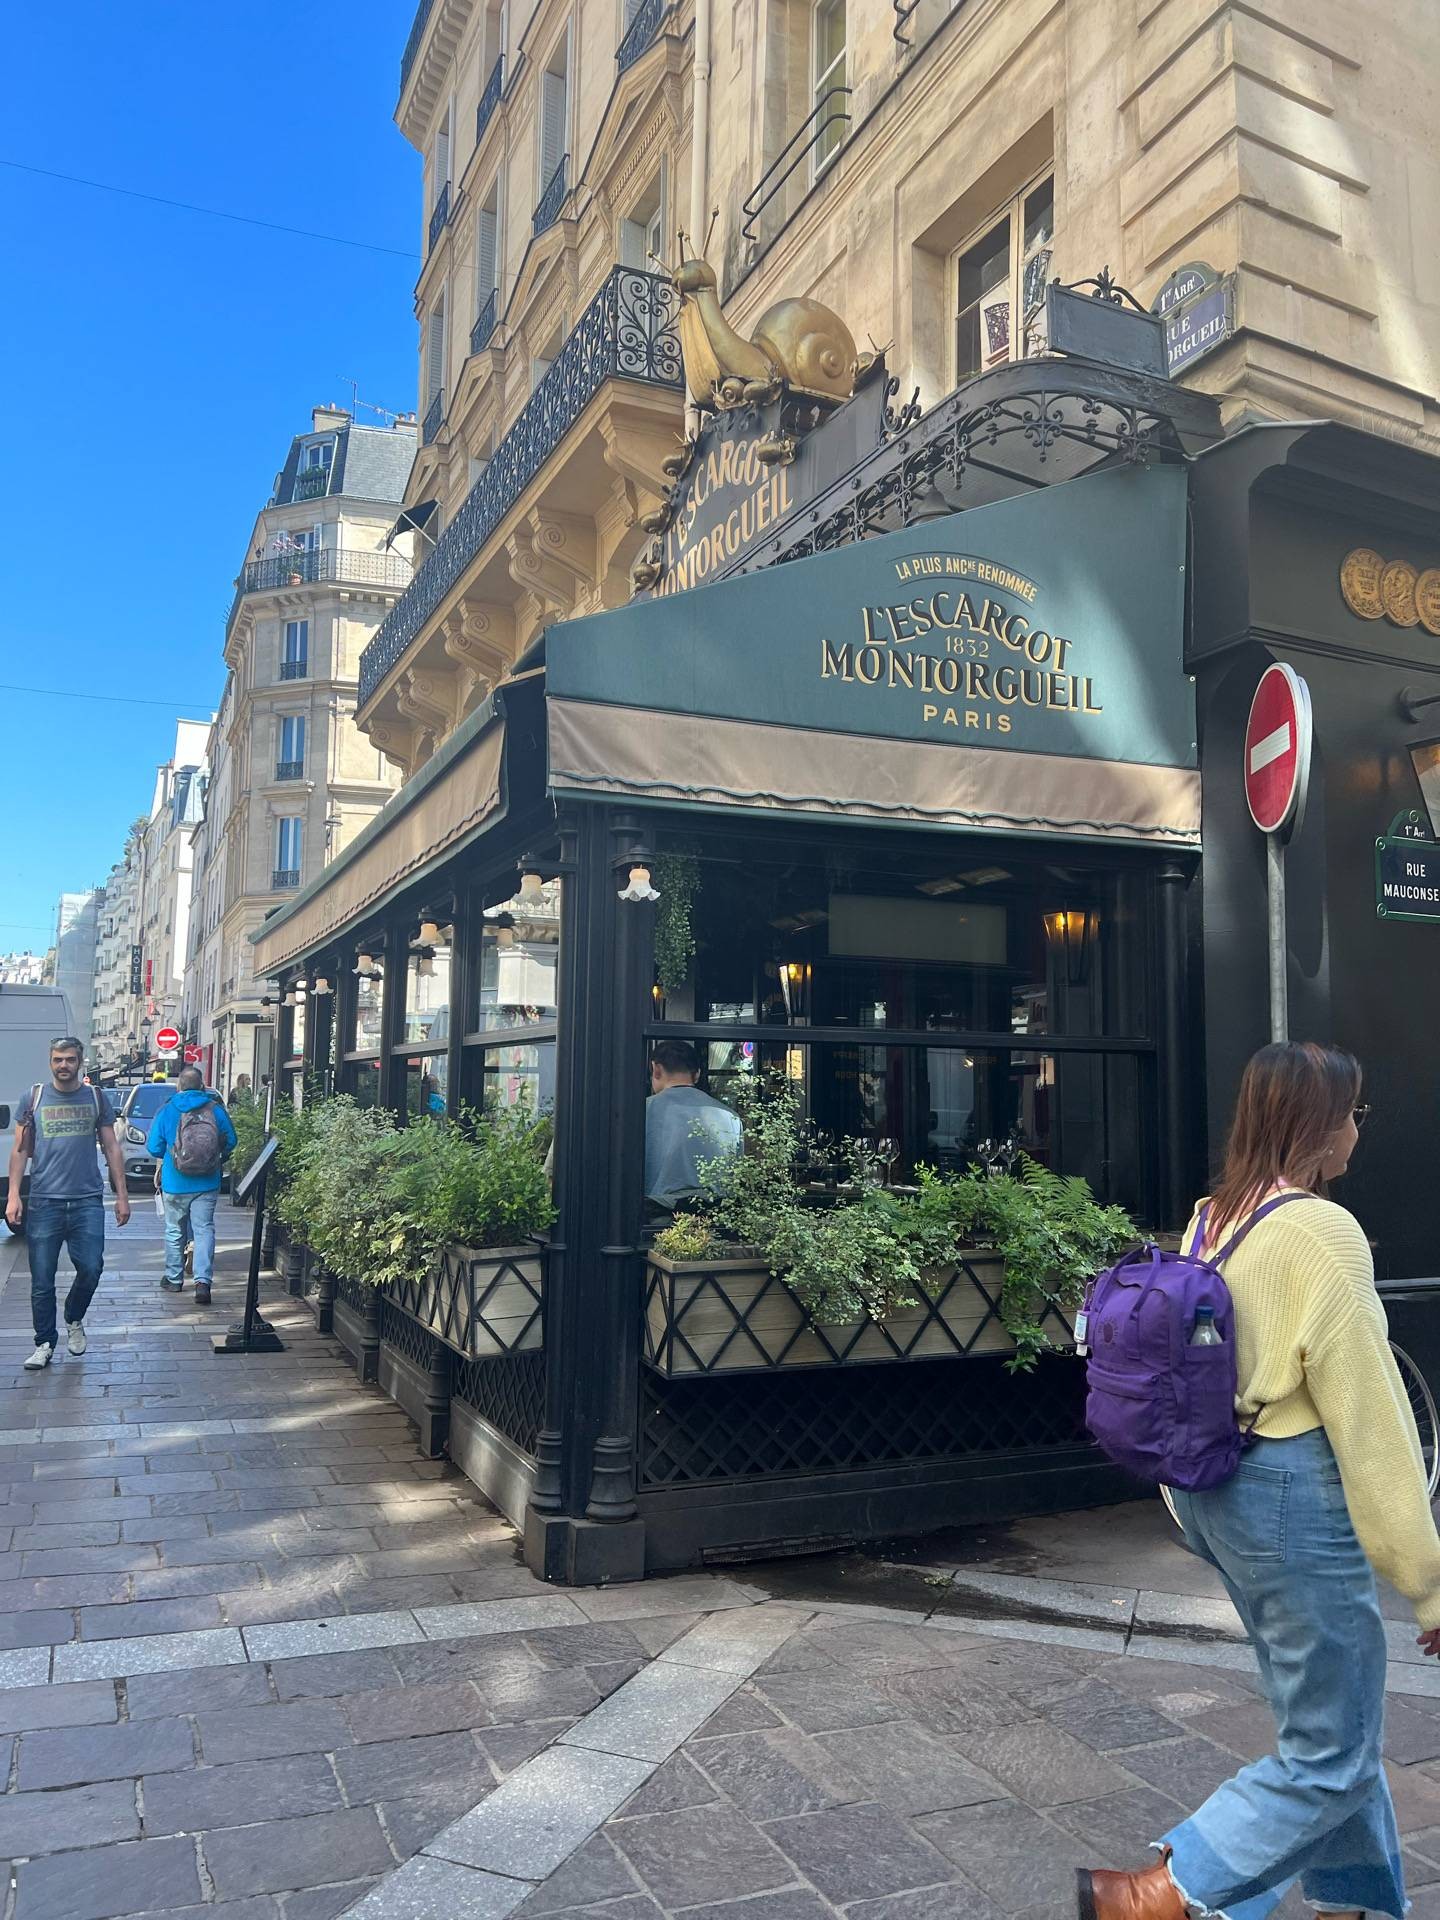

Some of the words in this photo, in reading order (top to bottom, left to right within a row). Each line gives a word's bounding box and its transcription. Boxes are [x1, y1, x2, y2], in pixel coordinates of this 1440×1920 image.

[1167, 316, 1191, 345] UE
[895, 564, 912, 580] LA
[913, 557, 942, 576] PLUS
[977, 562, 1038, 603] RENOMMÉE
[862, 591, 1073, 673] L'ESCARGOT
[944, 635, 990, 659] 1832
[820, 639, 1103, 714] MONTORGUEIL
[923, 703, 1013, 734] PARIS
[1406, 862, 1426, 877] RUE
[1383, 883, 1440, 902] MAUCONSE
[133, 948, 141, 992] HÔTEL
